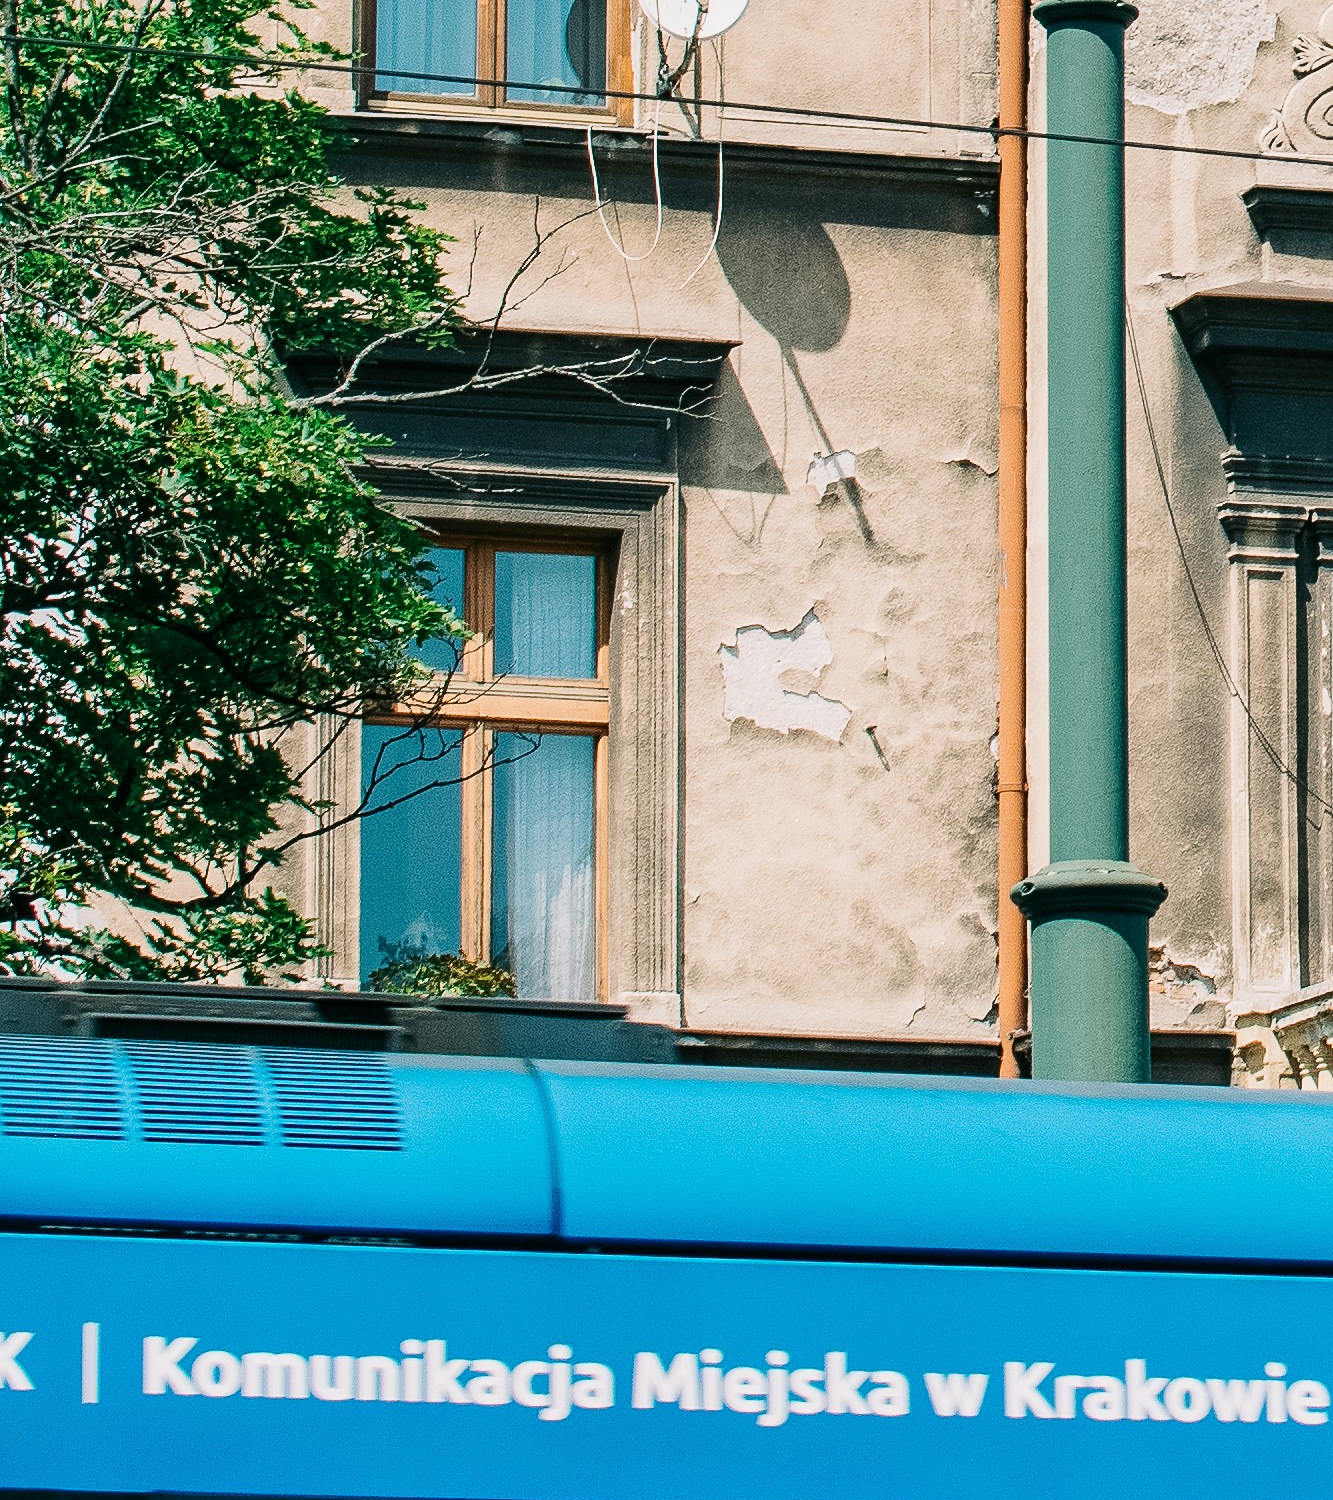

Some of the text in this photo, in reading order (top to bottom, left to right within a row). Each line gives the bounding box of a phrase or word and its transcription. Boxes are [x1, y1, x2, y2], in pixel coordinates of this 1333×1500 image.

[142, 1335, 614, 1422] Komunikacja
[631, 1348, 911, 1428] Miejska
[923, 1372, 989, 1418] w
[1003, 1358, 1331, 1426] Krakowie
